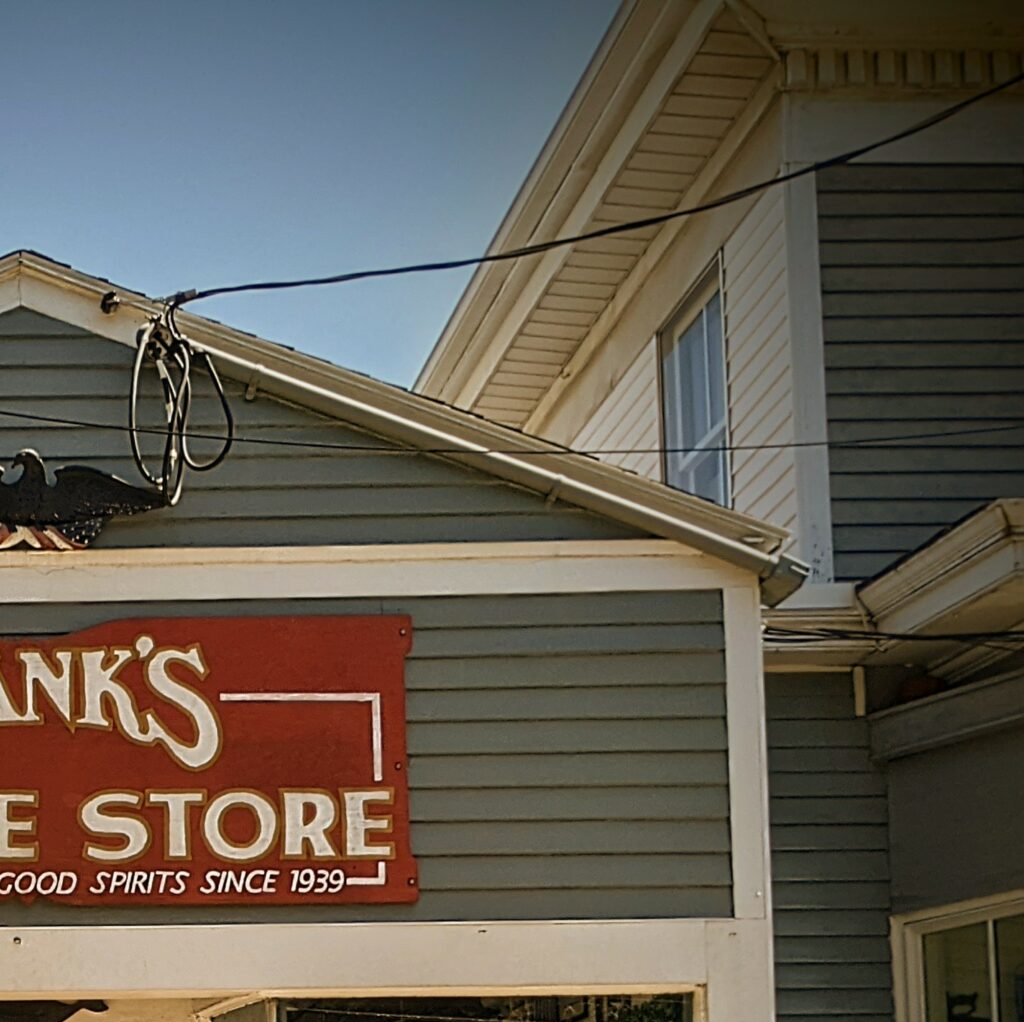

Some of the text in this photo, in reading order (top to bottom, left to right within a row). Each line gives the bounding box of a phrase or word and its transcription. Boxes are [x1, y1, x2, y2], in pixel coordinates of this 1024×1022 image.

[82, 788, 395, 861] STORE
[88, 870, 190, 895] SPIRITS
[198, 869, 281, 894] SINCE
[288, 869, 345, 894] 1939
